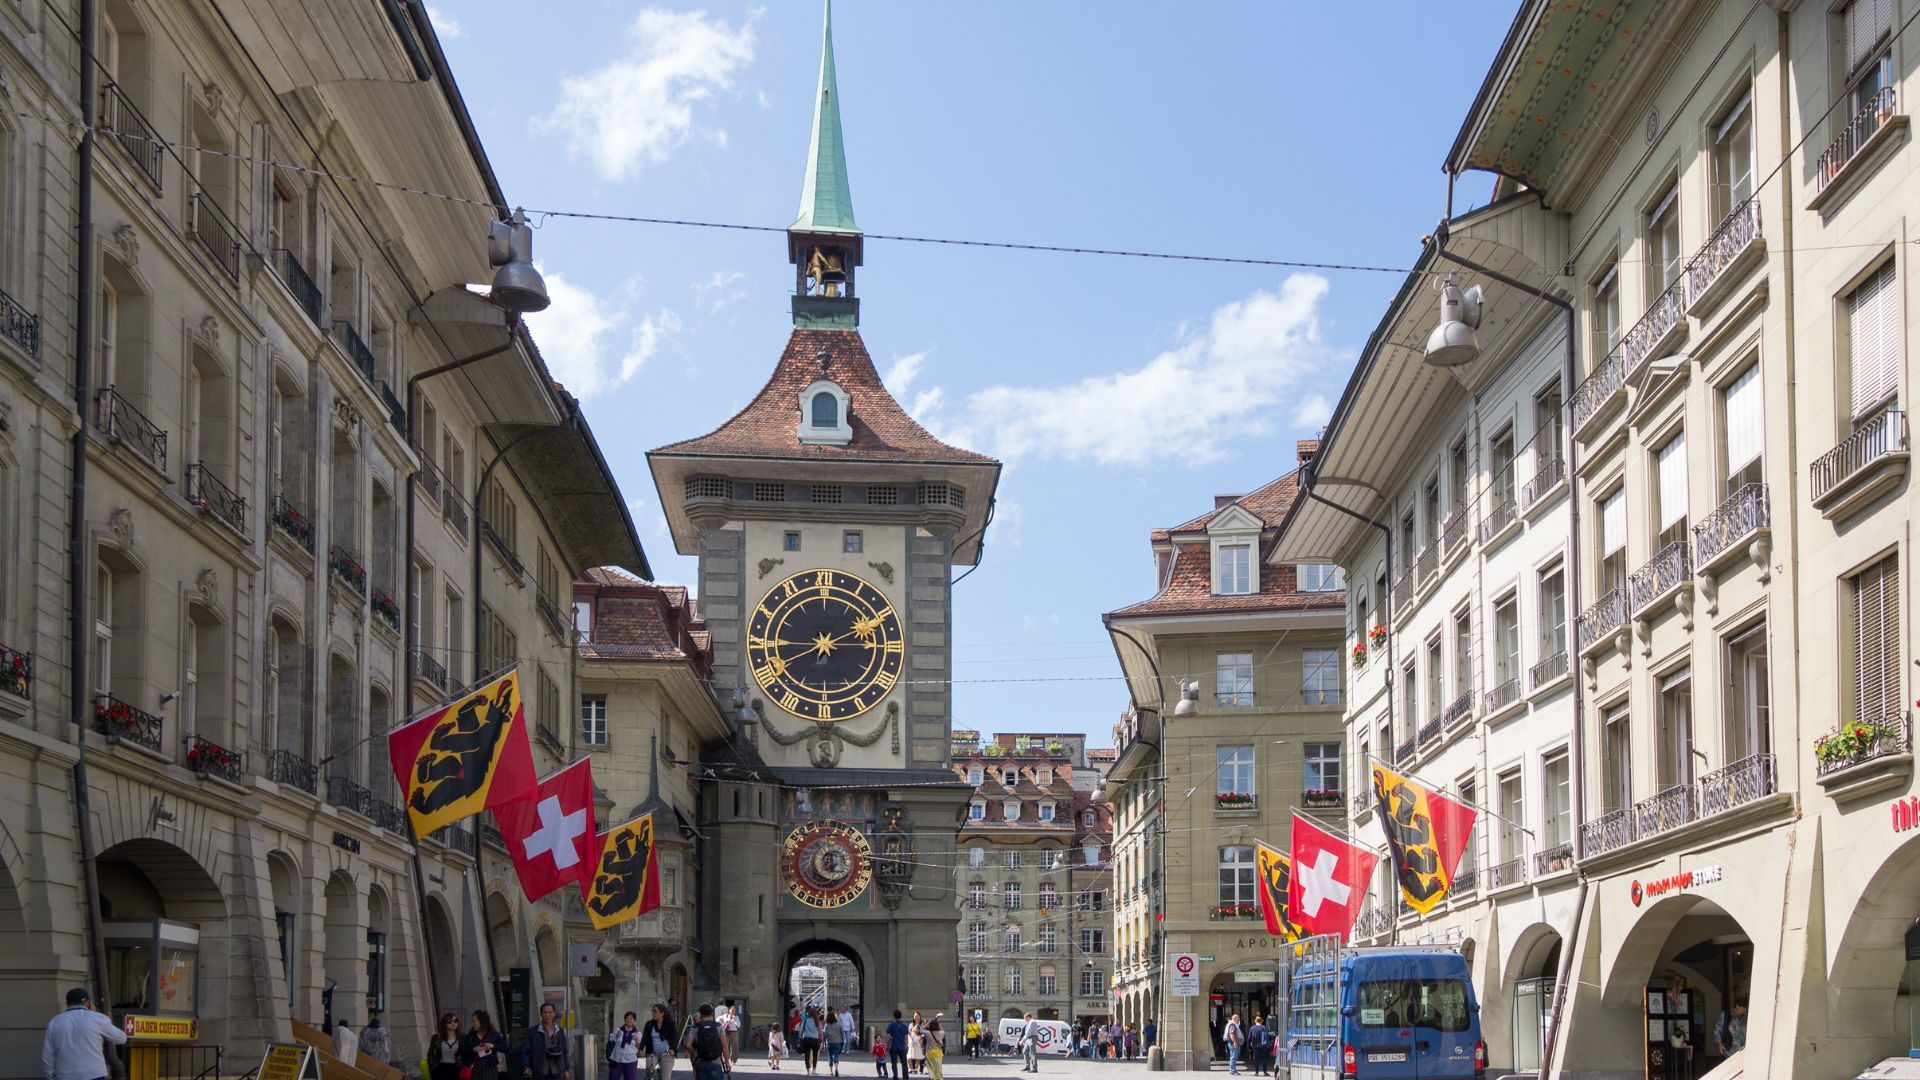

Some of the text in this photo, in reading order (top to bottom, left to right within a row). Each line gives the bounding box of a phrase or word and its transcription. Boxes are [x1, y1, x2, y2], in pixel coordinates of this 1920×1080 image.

[815, 571, 833, 586] XII
[782, 579, 799, 598] XI
[759, 604, 773, 619] X
[1891, 796, 1920, 833] thi
[1645, 864, 1722, 897] MAMMUT STORE
[135, 1021, 158, 1033] BADER
[1006, 1027, 1025, 1035] DP
